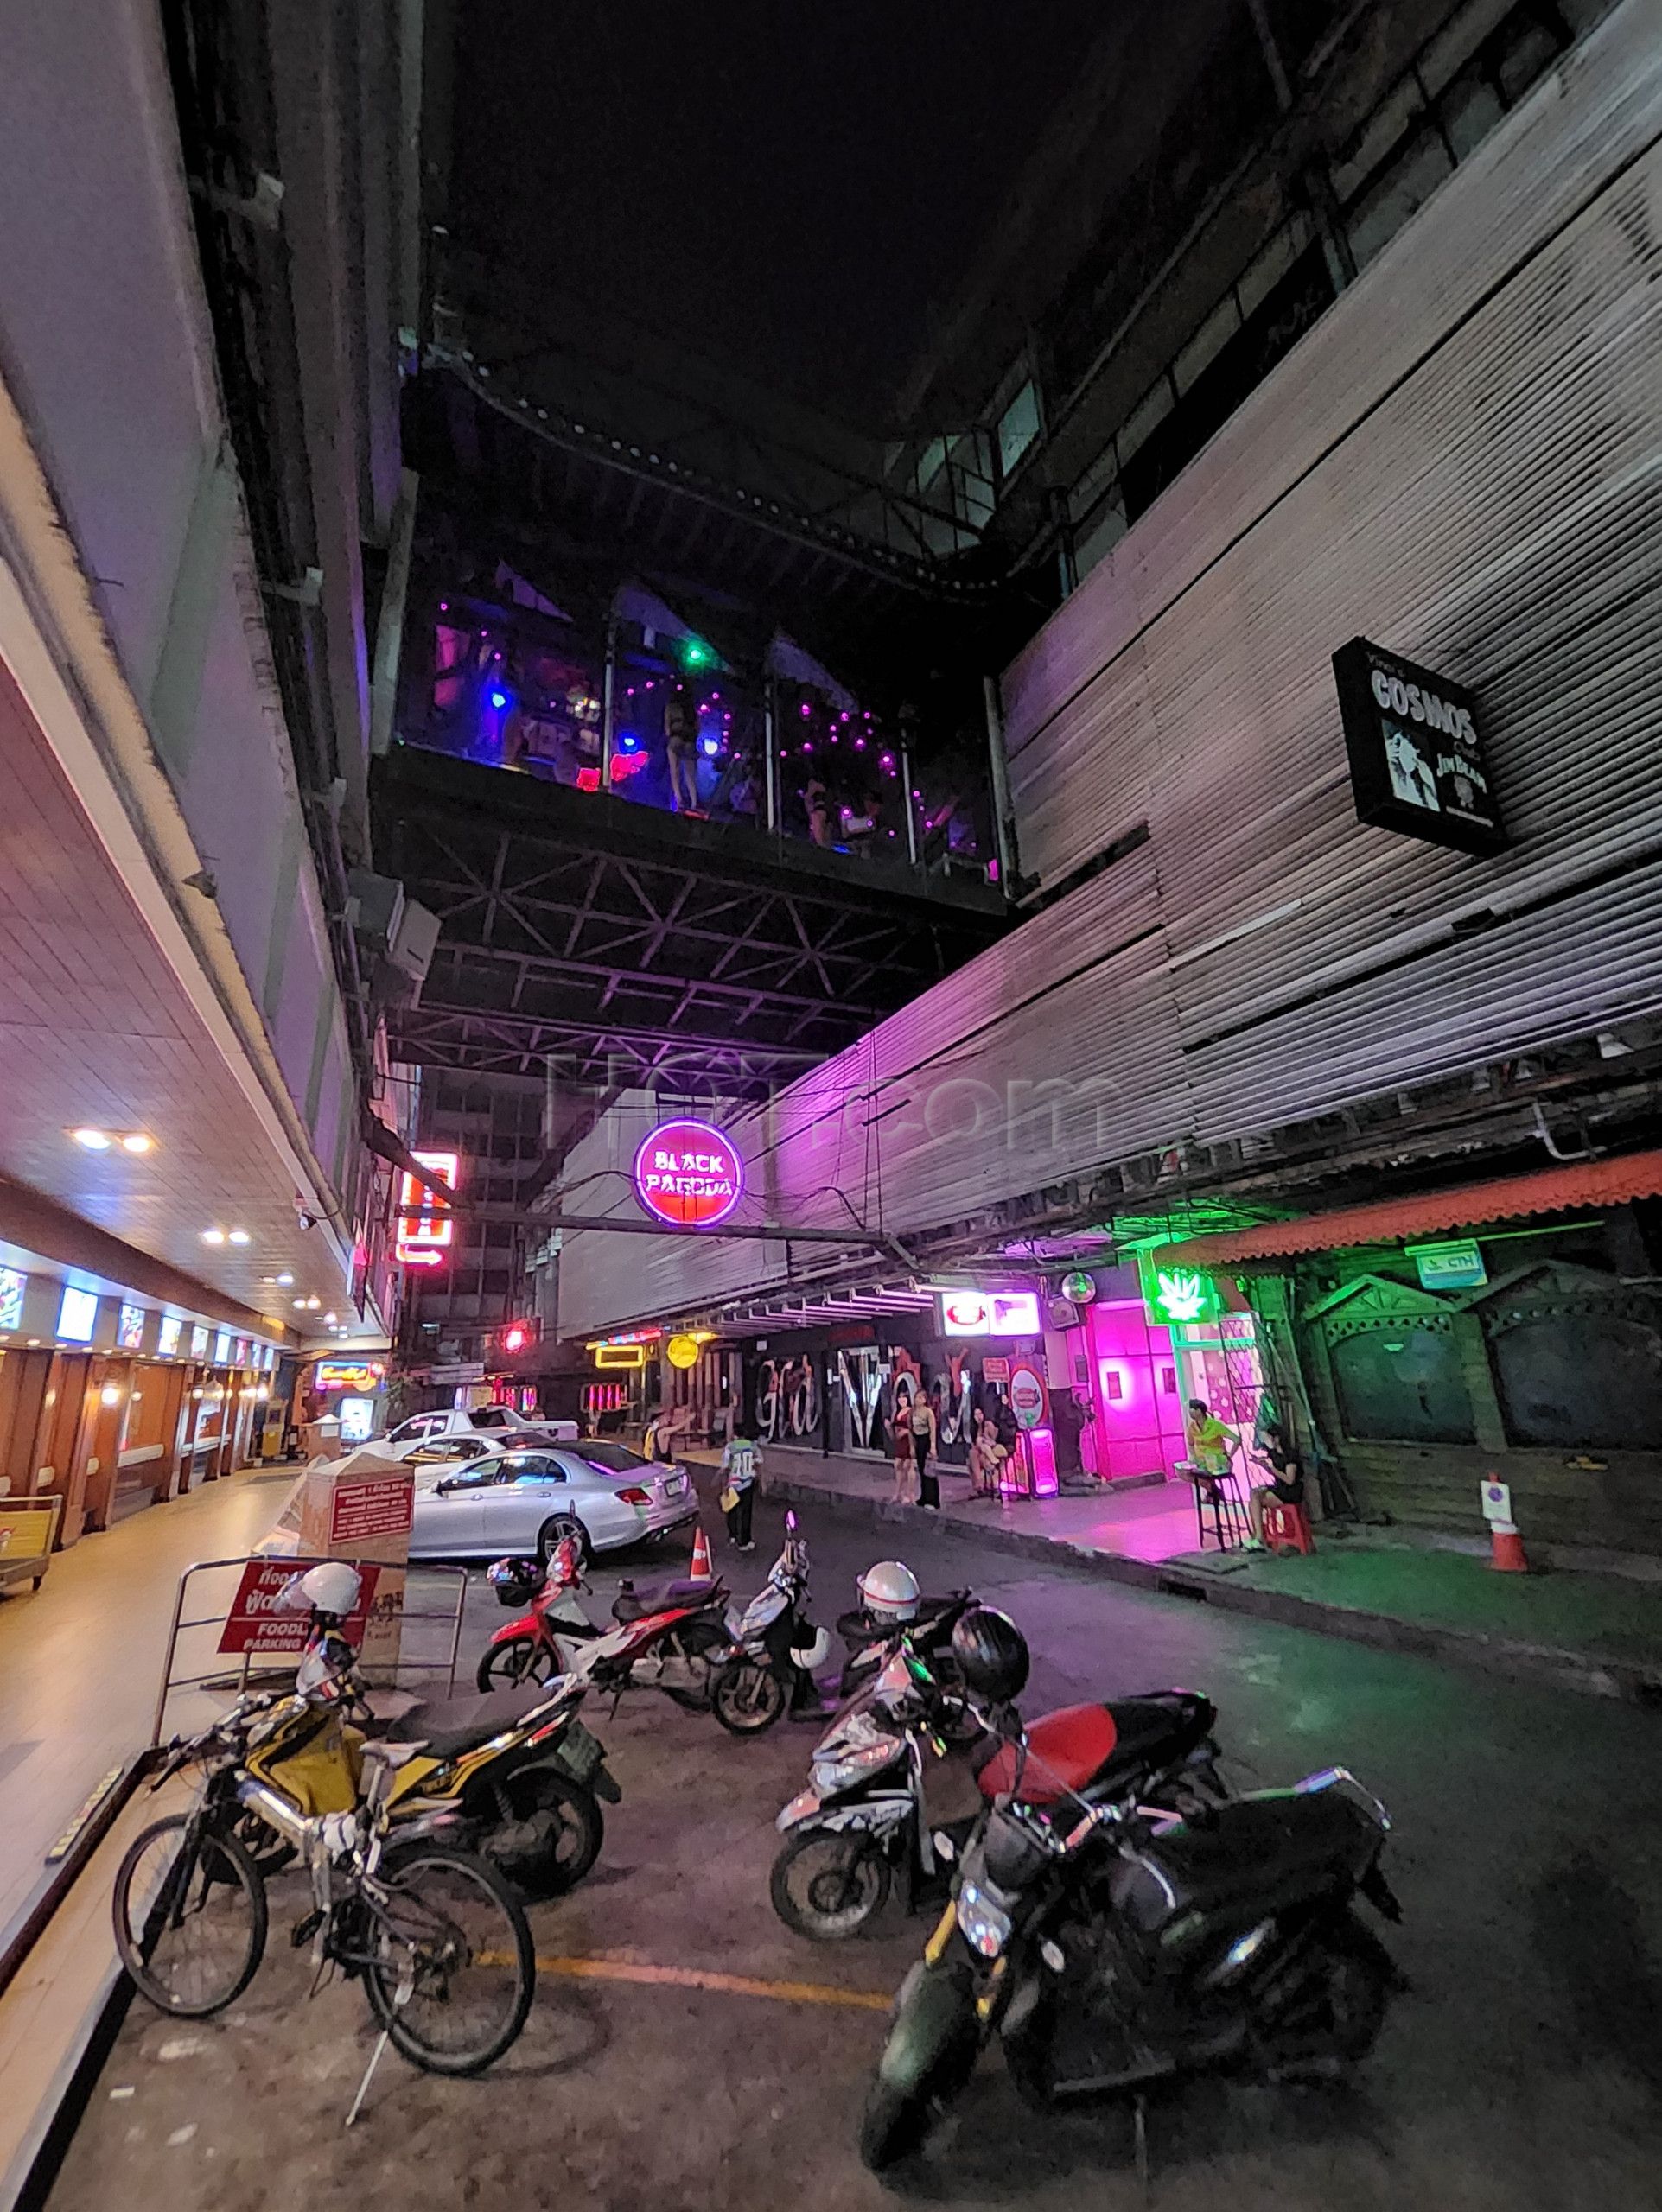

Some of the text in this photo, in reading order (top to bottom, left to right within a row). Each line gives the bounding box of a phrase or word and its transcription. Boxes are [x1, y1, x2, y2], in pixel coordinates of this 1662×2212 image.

[1371, 669, 1478, 745] COSMOS
[653, 1150, 724, 1173] BLACK
[257, 1623, 309, 1637] FOODL
[243, 1638, 302, 1650] PARKING
